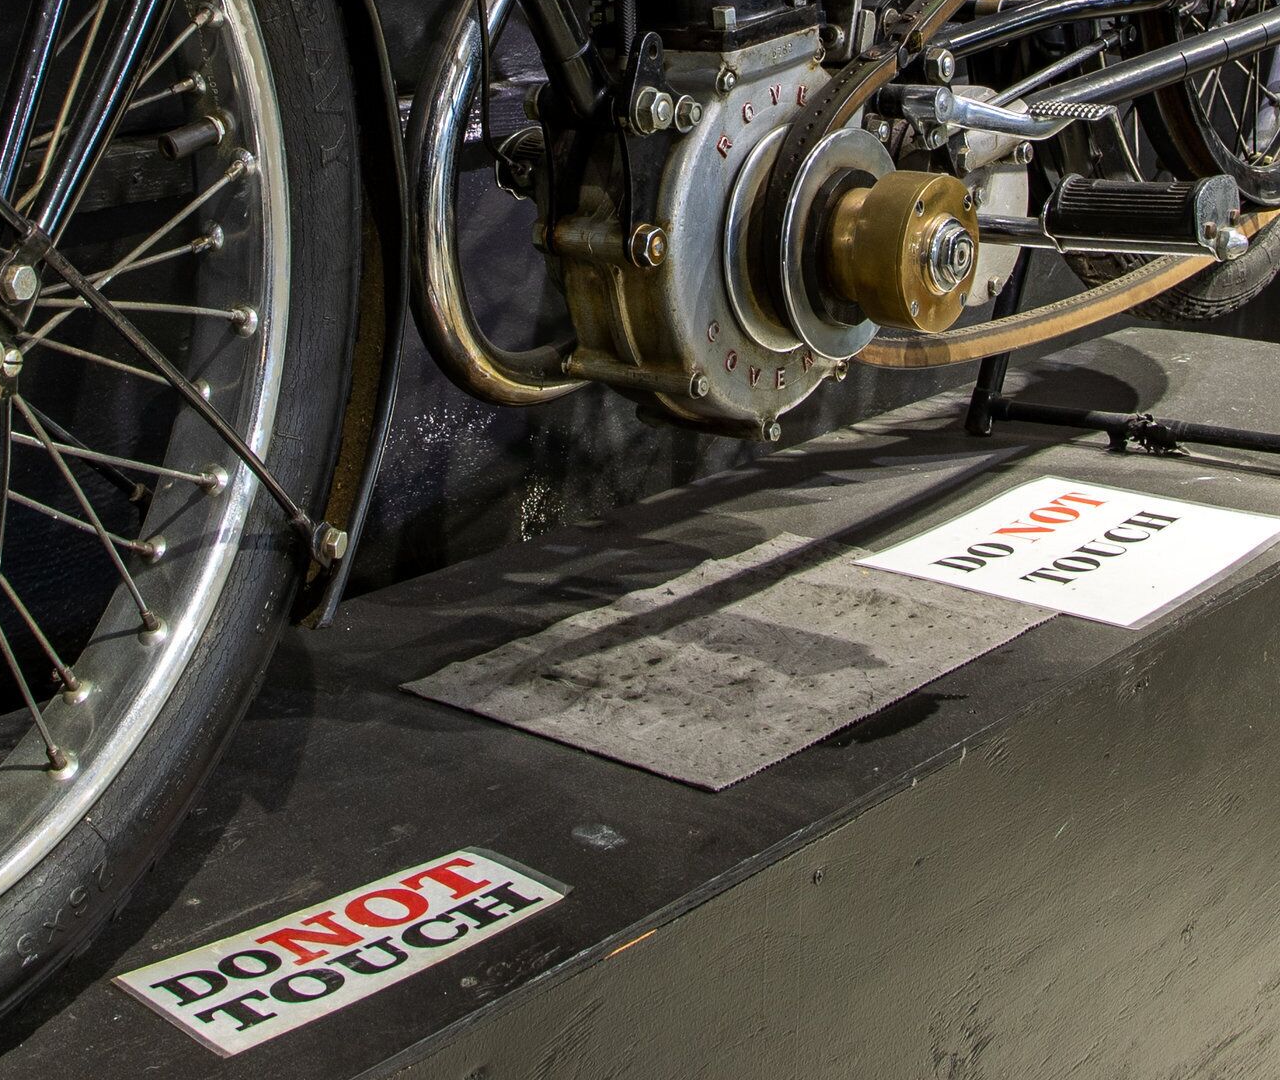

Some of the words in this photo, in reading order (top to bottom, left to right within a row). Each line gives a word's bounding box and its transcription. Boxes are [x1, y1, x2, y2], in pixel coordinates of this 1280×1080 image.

[716, 84, 809, 160] ROVE
[931, 541, 1015, 574] DO
[992, 491, 1108, 544] NOT
[1020, 510, 1183, 586] TOUCH
[149, 948, 283, 1007] DO
[256, 857, 492, 967] NOT
[194, 881, 543, 1032] TOUCH
